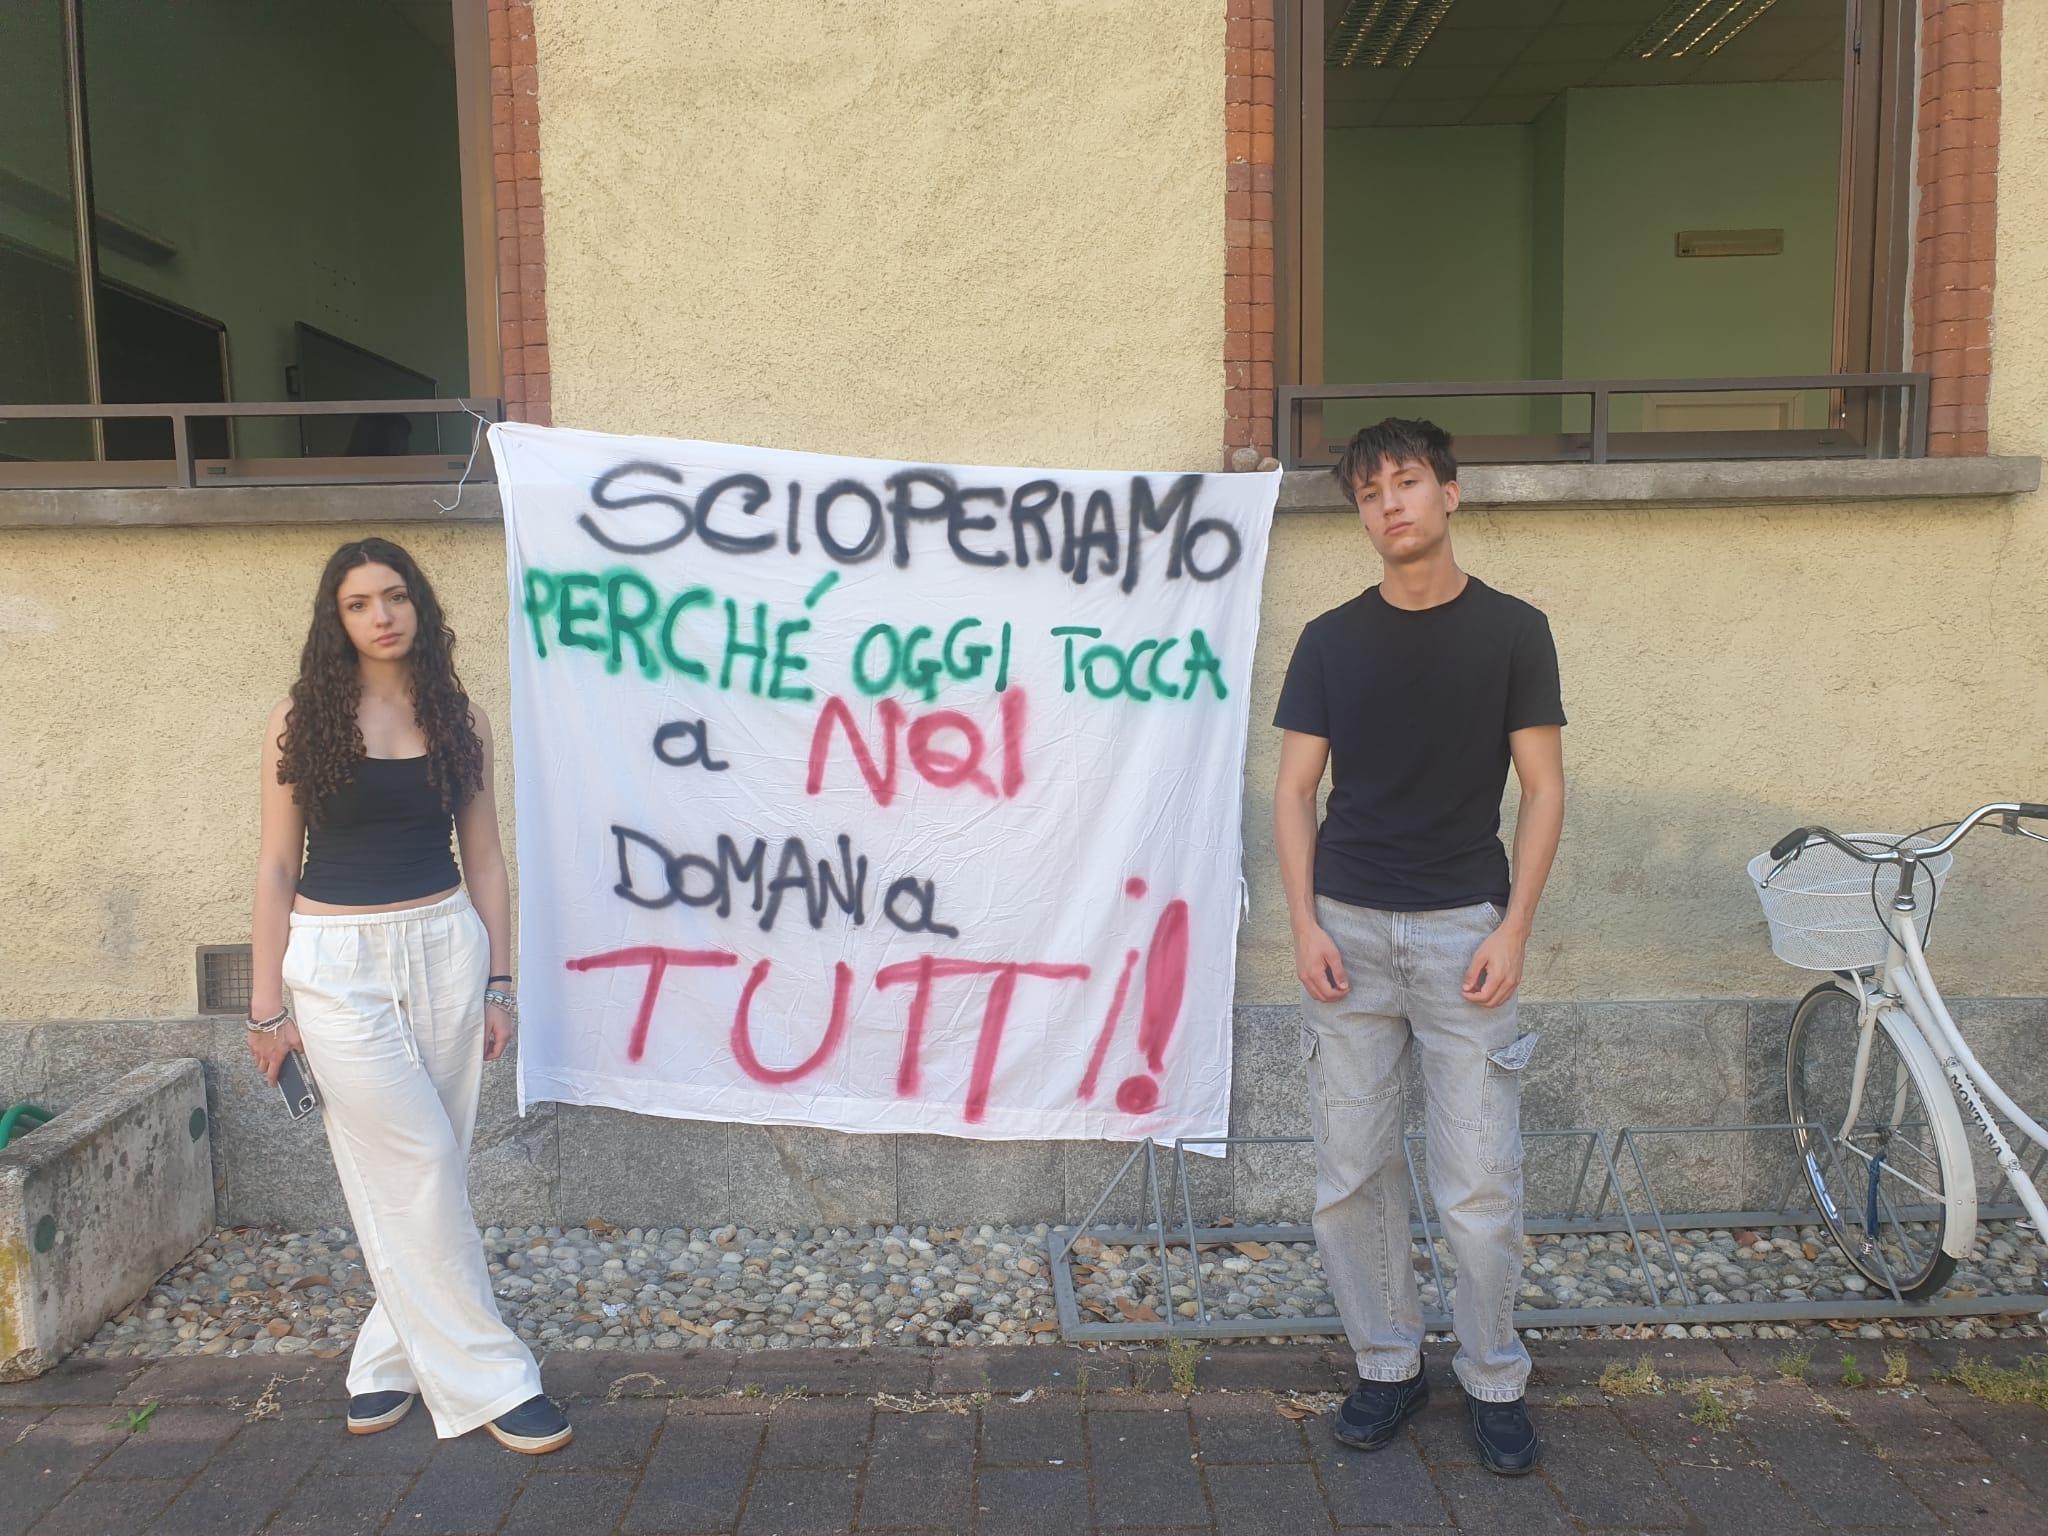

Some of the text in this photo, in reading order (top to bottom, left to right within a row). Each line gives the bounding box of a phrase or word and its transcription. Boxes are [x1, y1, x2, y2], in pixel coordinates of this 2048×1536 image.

[578, 462, 1242, 593] SCIOPERIAMO
[522, 568, 1229, 702] PERCHÉ OGGI TOCCA
[611, 825, 868, 931] DOMANI
[1950, 1073, 2003, 1157] MONTANA
